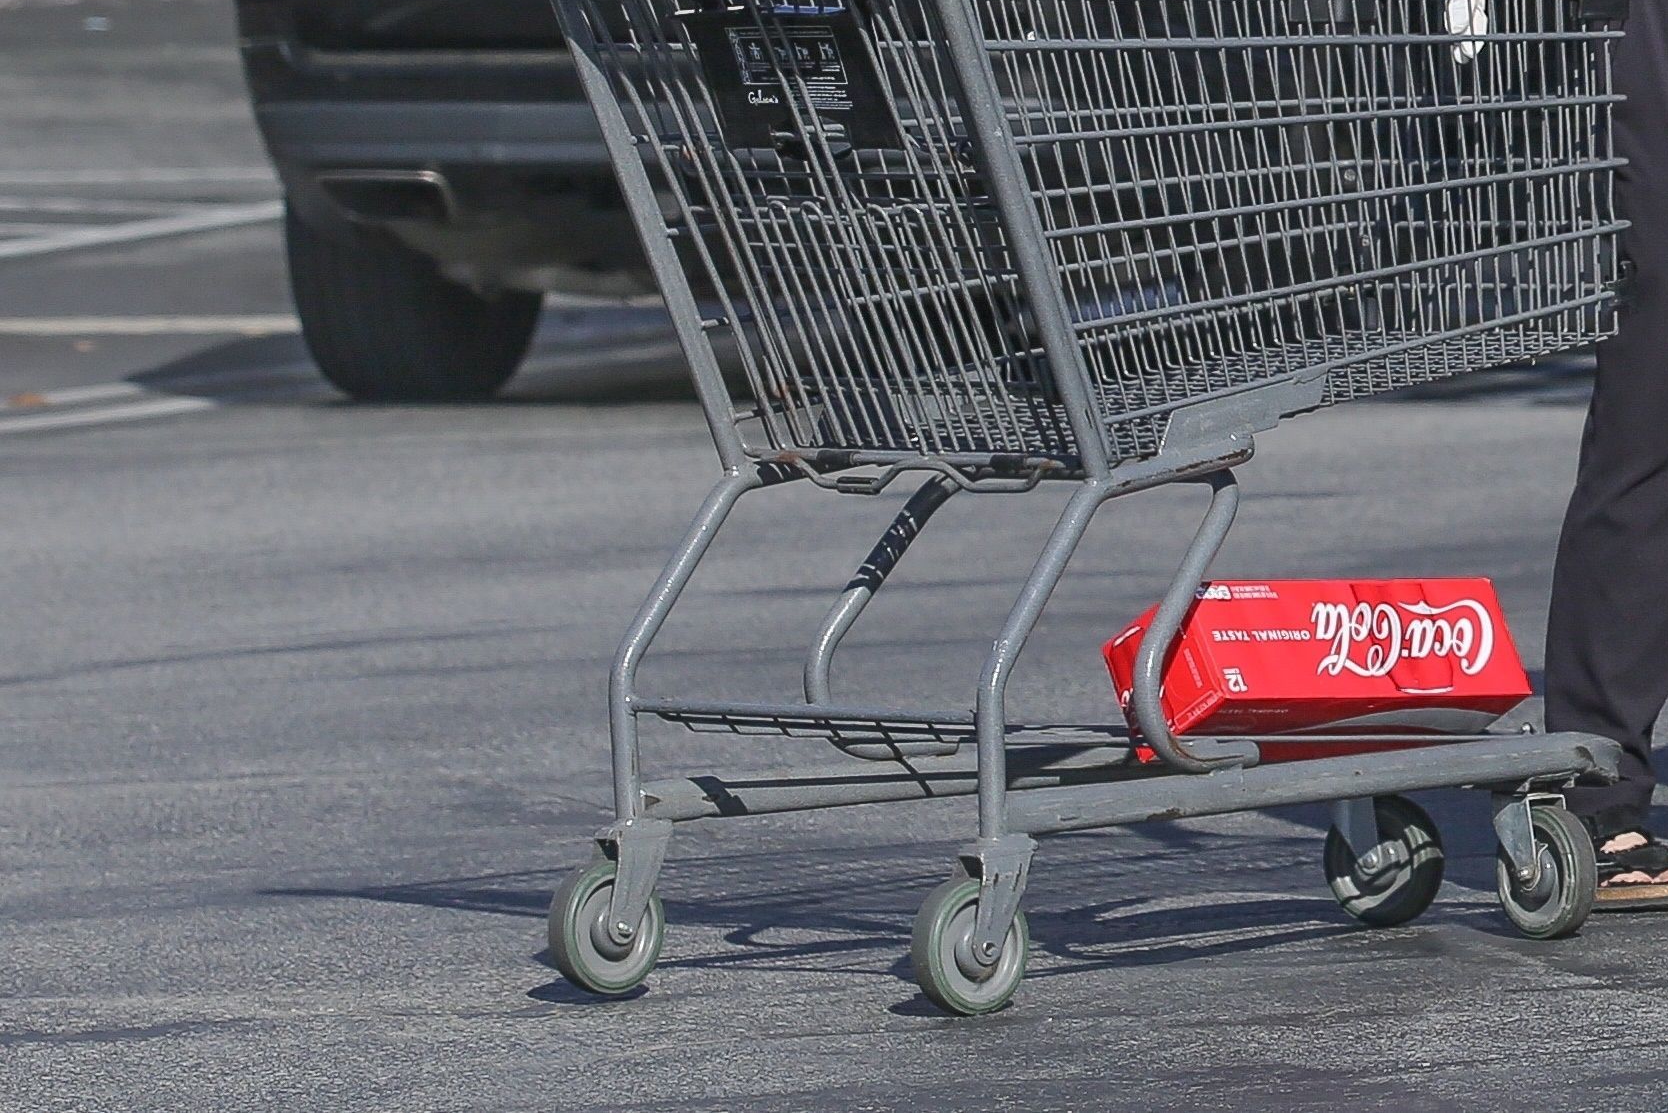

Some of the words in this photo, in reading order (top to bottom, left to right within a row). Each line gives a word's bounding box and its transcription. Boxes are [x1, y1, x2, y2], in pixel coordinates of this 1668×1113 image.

[1211, 629, 1250, 642] TASTE
[1251, 629, 1310, 642] ORIGINAL
[1223, 673, 1248, 693] 12
